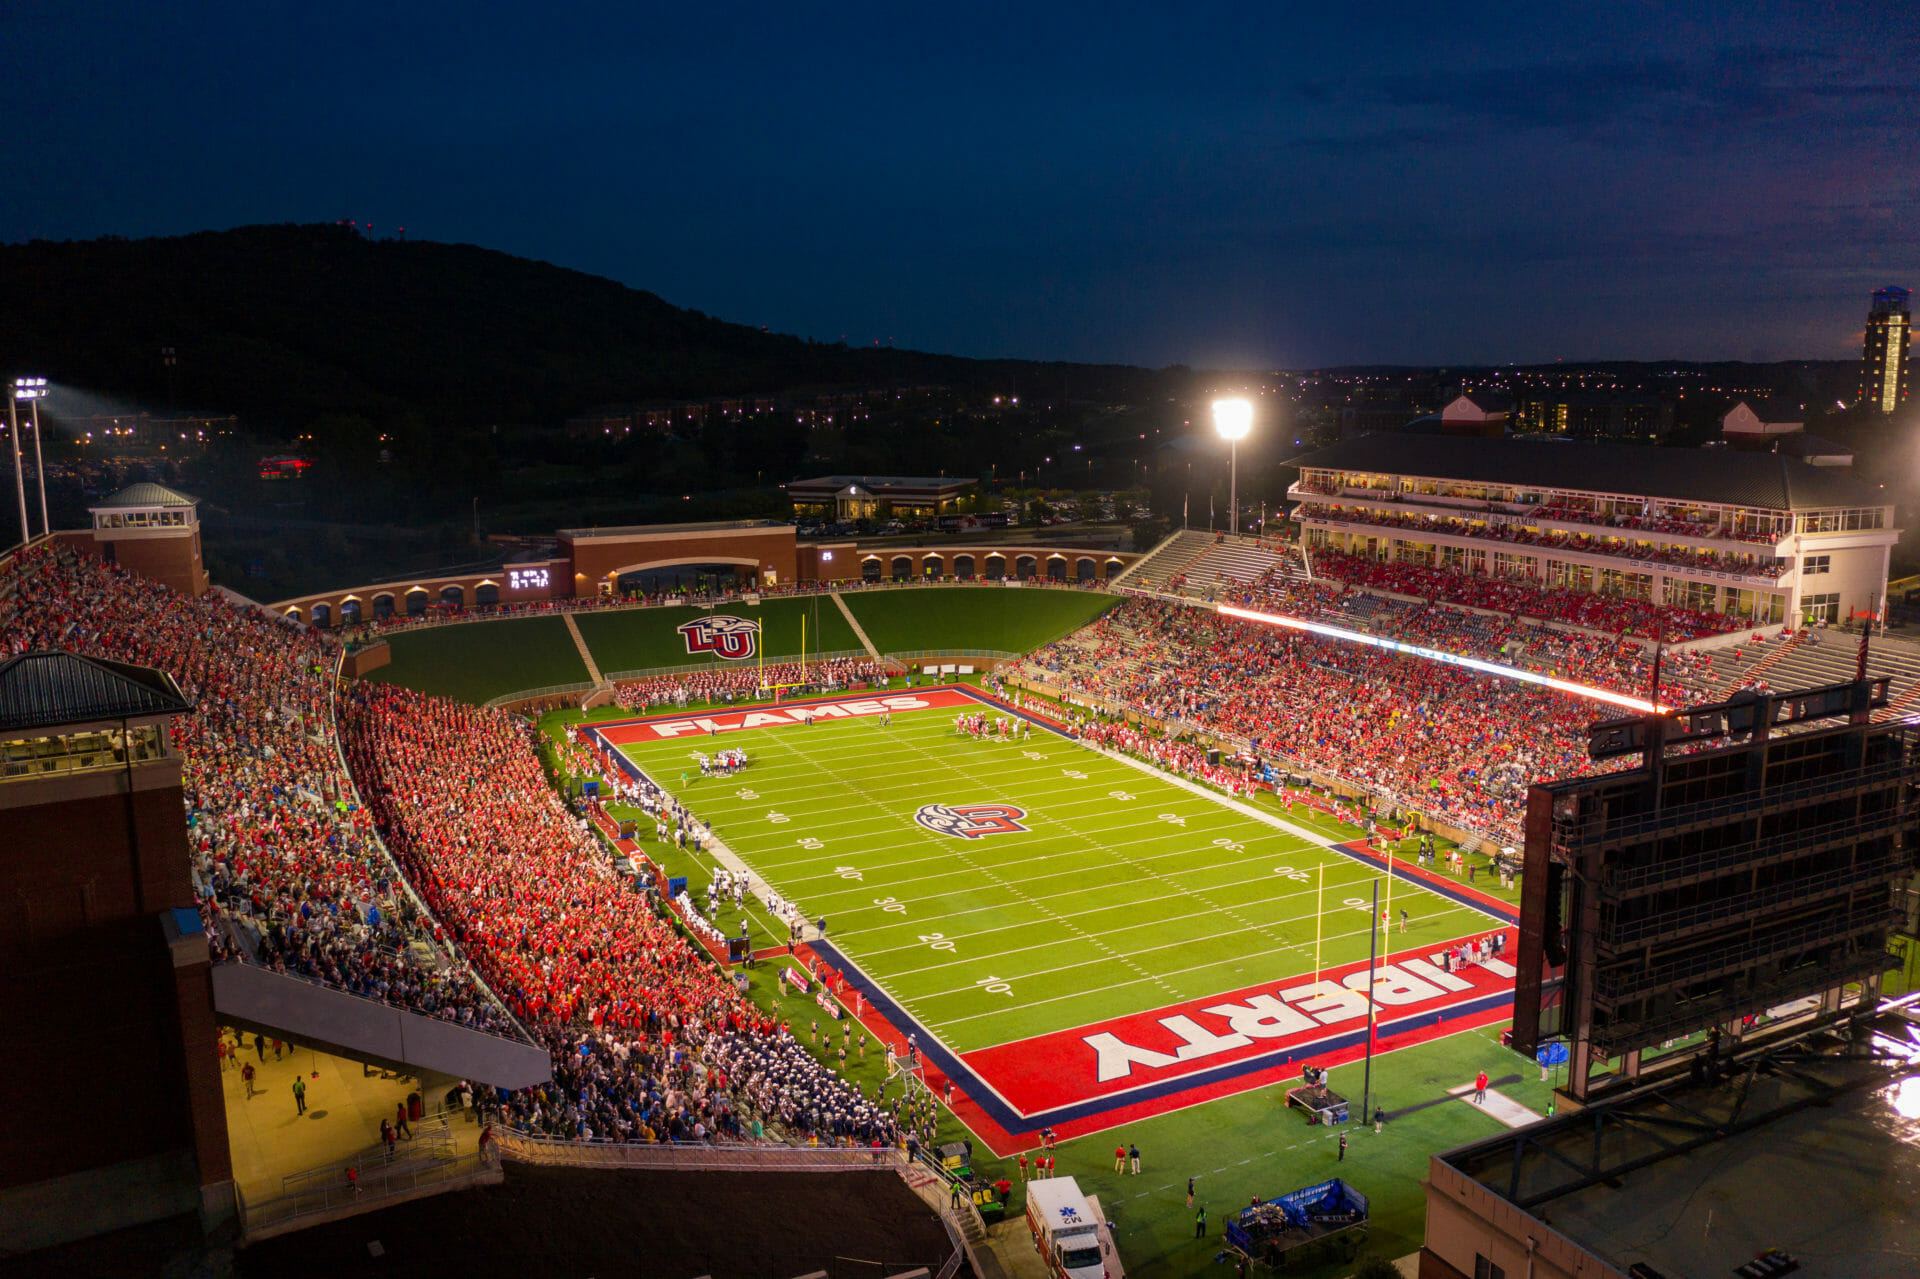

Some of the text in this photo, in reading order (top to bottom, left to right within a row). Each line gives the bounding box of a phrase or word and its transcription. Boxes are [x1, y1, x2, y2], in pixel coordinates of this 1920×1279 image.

[1460, 510, 1481, 520] HOME
[1505, 515, 1538, 527] FLAMES
[649, 696, 931, 738] FLAMES
[796, 837, 824, 850] 50
[1212, 838, 1246, 851] 30
[834, 866, 863, 879] 40
[1273, 866, 1312, 881] 20
[873, 896, 906, 912] 30
[918, 932, 956, 950] 20
[975, 975, 1012, 994] 10
[1062, 1215, 1083, 1225] M2
